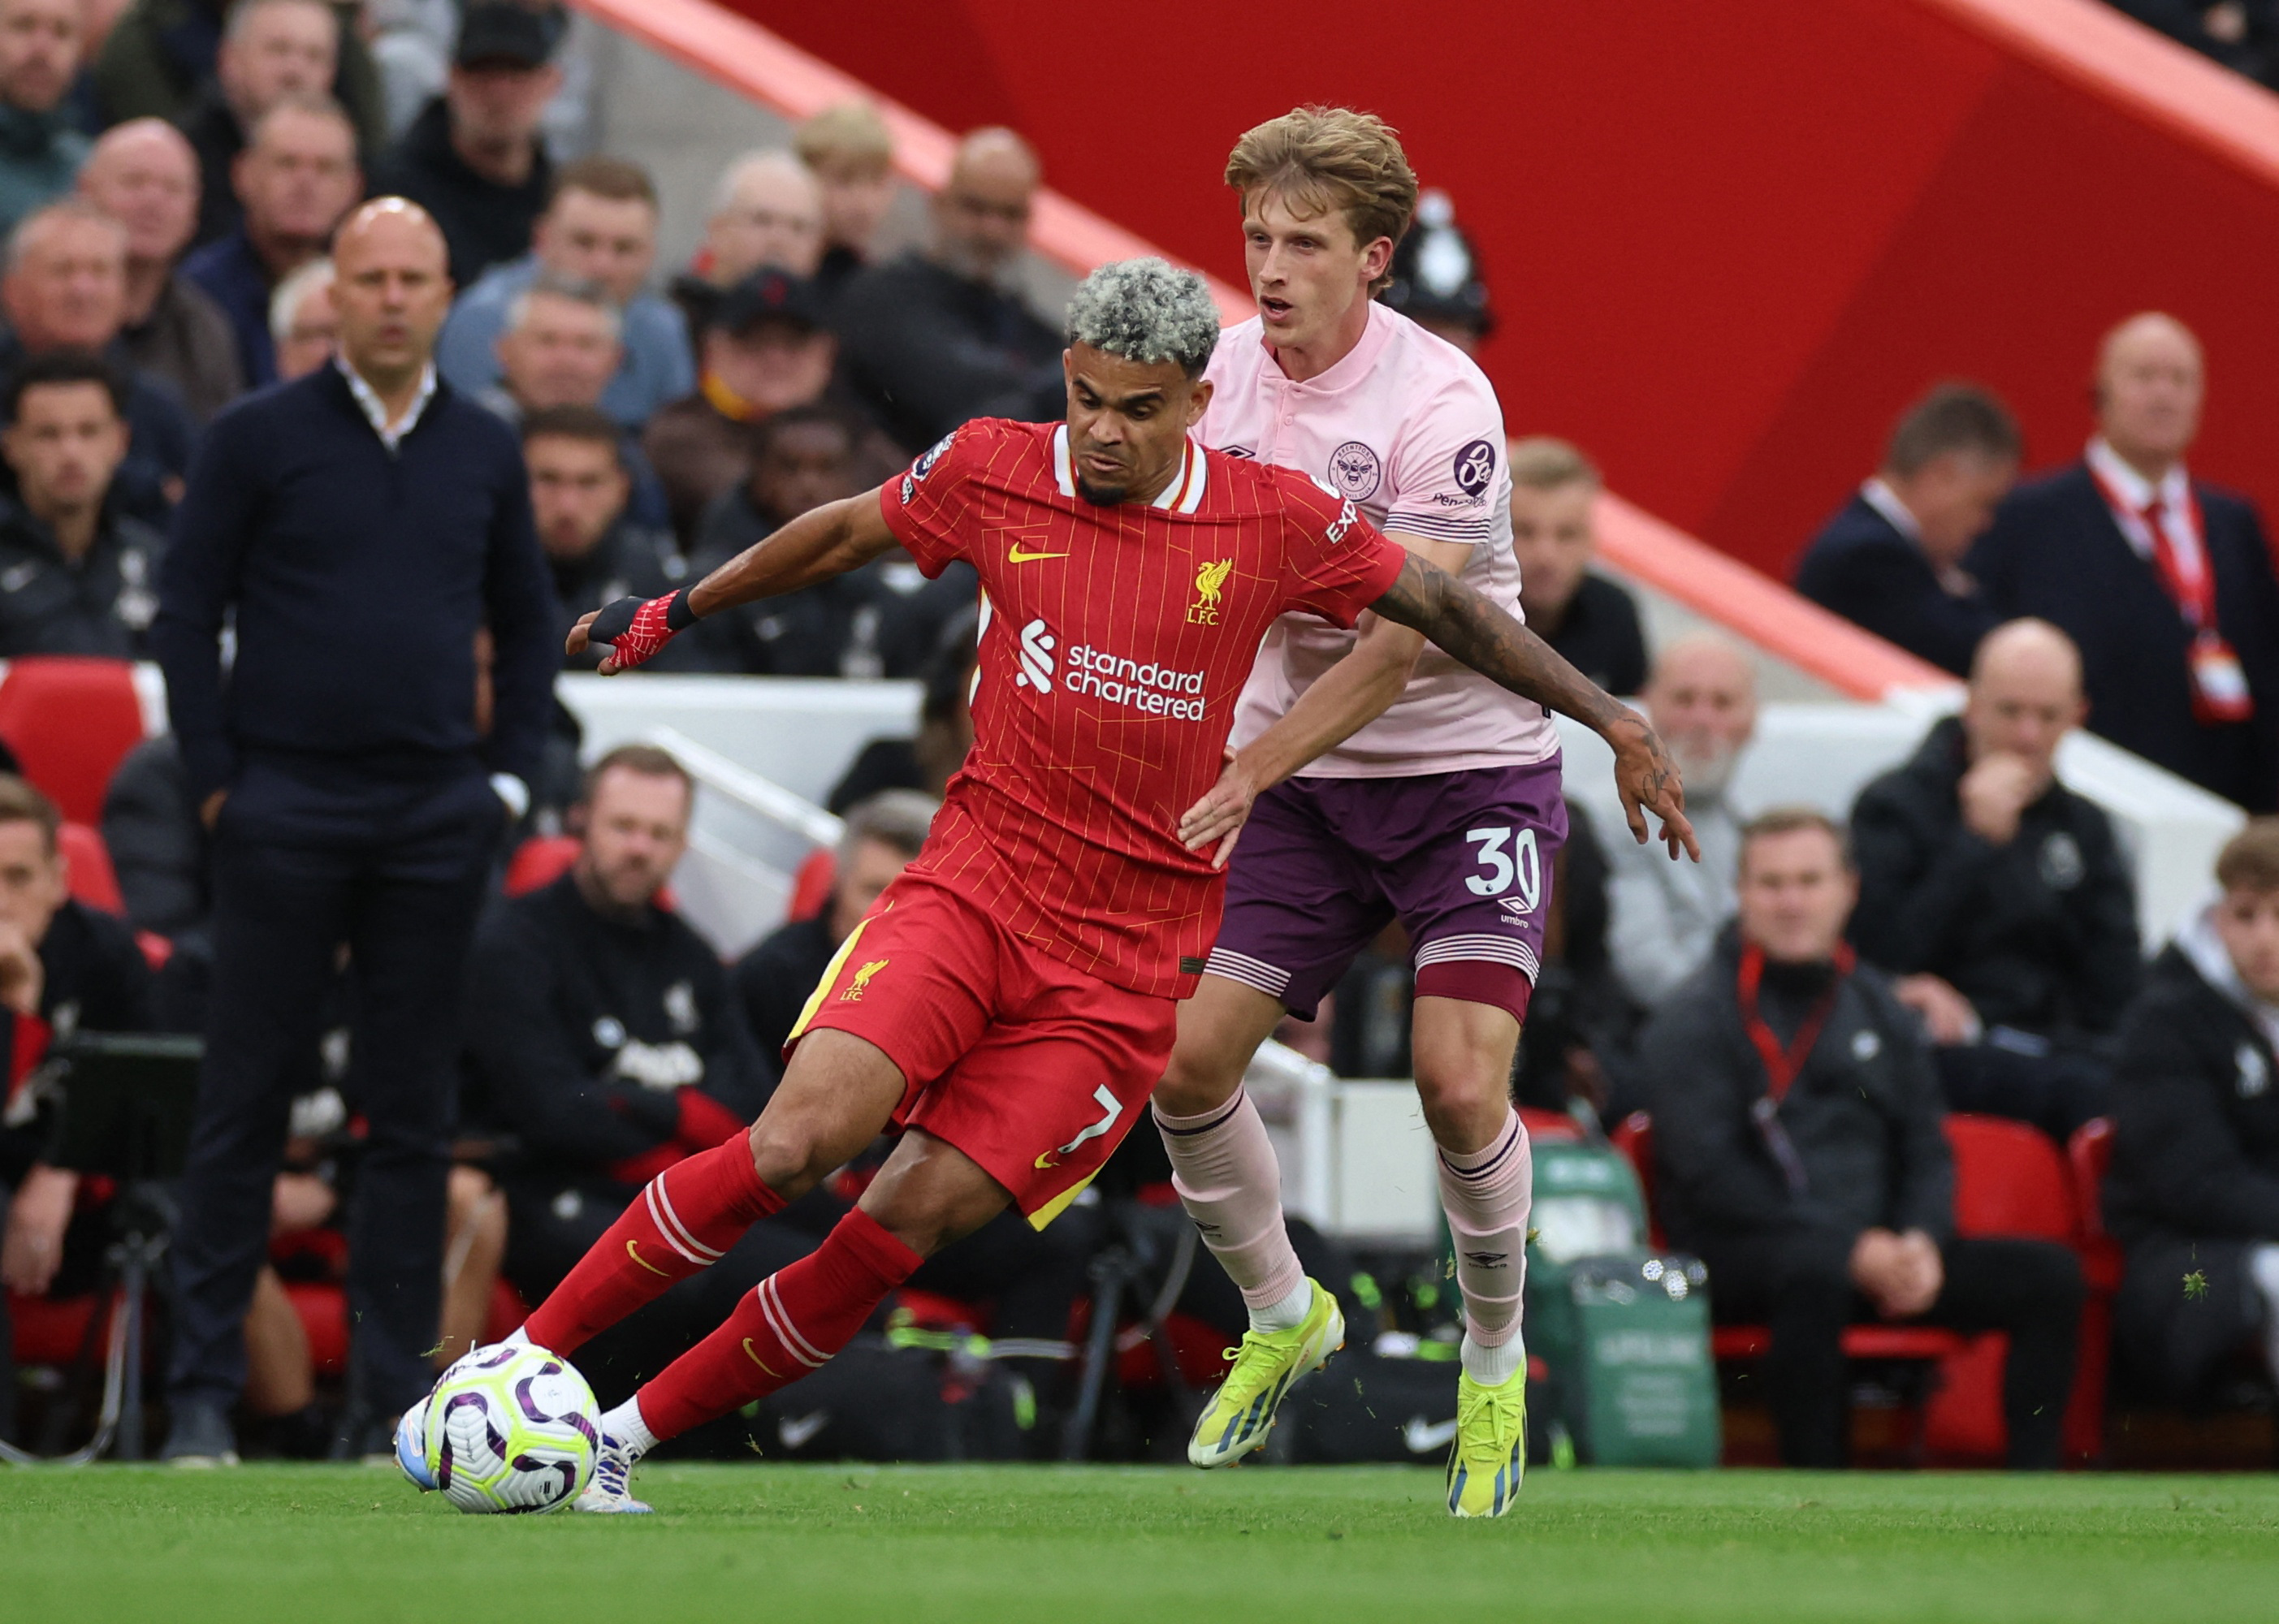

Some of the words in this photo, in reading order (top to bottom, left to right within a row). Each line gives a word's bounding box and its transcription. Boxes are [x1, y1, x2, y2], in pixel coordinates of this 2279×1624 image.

[1337, 444, 1373, 462] BRENTFORD
[1358, 486, 1372, 498] CLUB
[1068, 644, 1204, 694] standard
[1066, 670, 1205, 721] chartered
[1464, 827, 1541, 910] 30
[1500, 914, 1529, 929] umbro
[1057, 1083, 1123, 1154] 7
